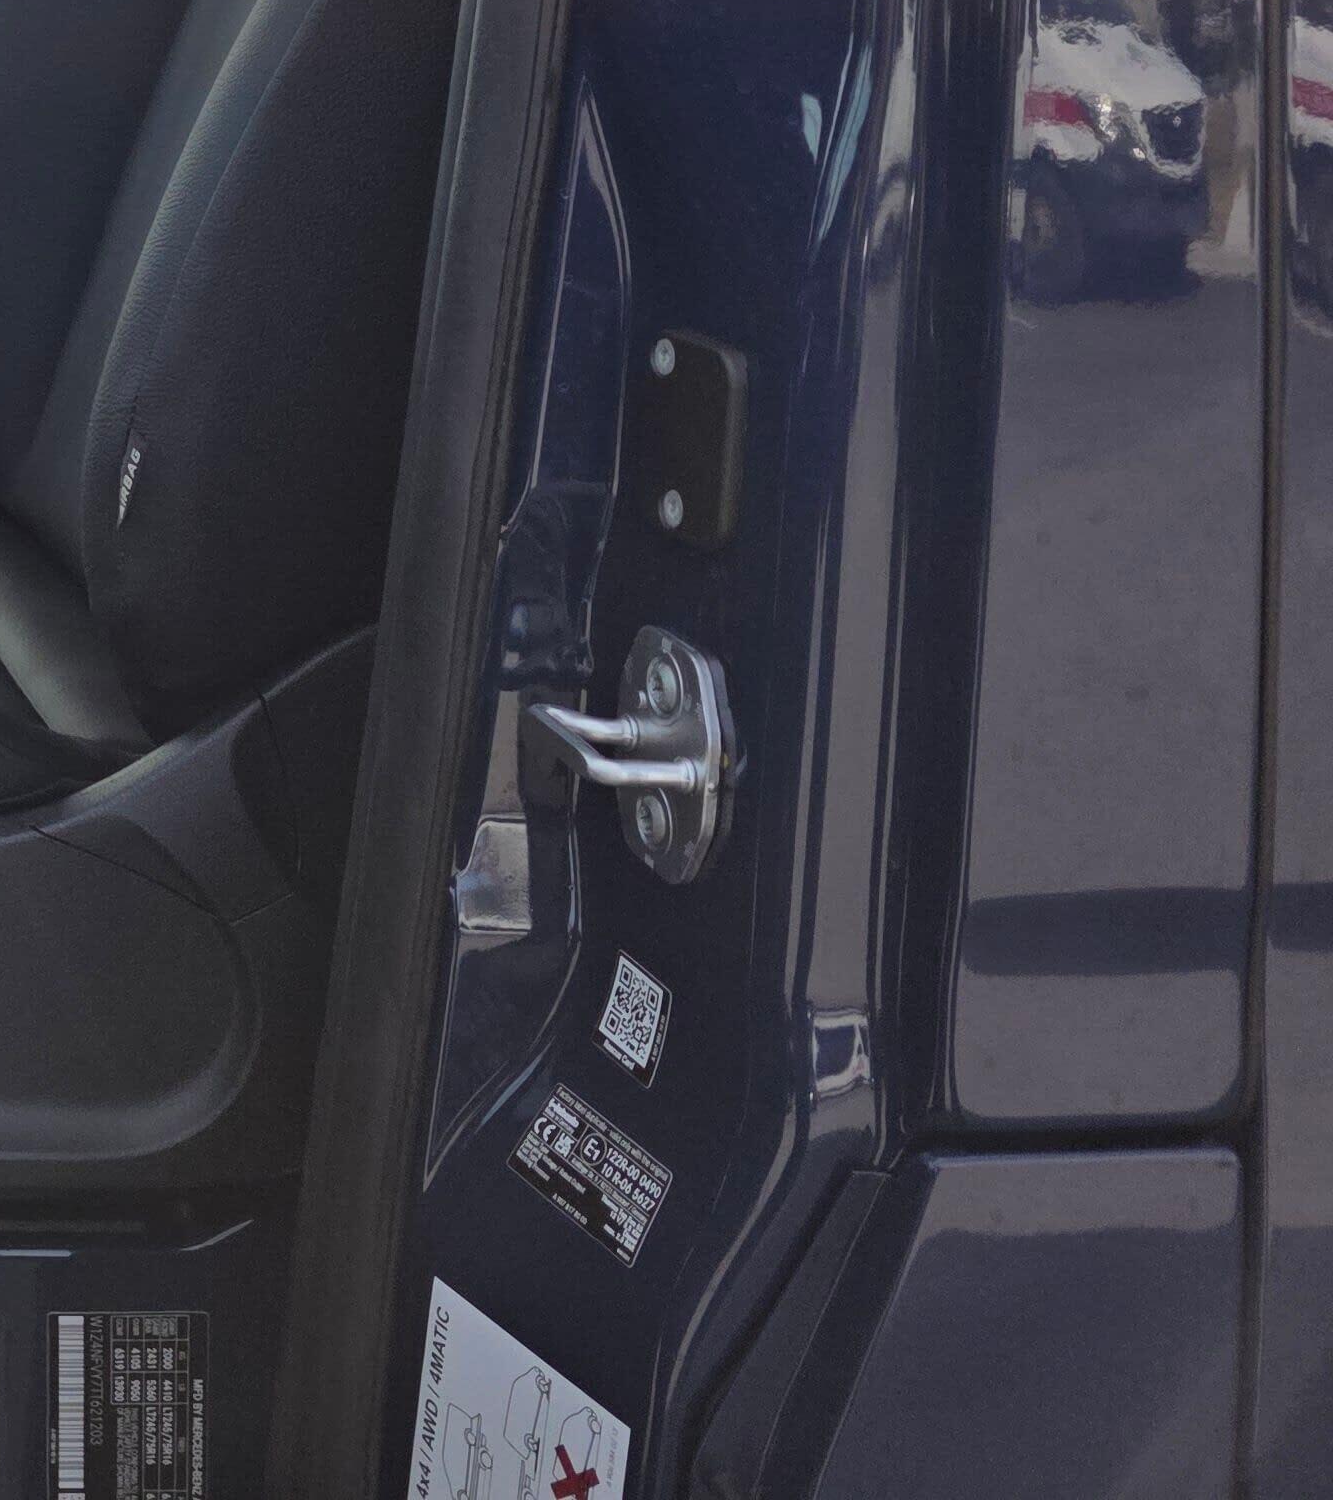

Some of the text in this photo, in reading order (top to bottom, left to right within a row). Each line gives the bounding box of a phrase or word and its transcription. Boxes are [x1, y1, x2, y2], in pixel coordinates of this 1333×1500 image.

[583, 1138, 601, 1161] E1
[606, 1148, 641, 1181] 122R-00
[639, 1174, 661, 1199] 0490
[601, 1162, 655, 1212] 10 R-06 5627
[429, 1306, 450, 1383] 4MATIC
[114, 1347, 125, 1369] 6319
[130, 1347, 140, 1369] 4105
[146, 1347, 156, 1369] 2431
[162, 1347, 172, 1369] 2000
[90, 1316, 102, 1445] W1Z4NFVY7TT621203
[114, 1375, 124, 1401] 13930
[130, 1379, 139, 1401] 9050
[146, 1379, 156, 1401] 5360
[162, 1379, 172, 1401] 4410
[192, 1379, 202, 1400] MFD
[192, 1402, 202, 1414] BY
[422, 1398, 438, 1447] AWD
[145, 1406, 156, 1464] LT245/75R16
[161, 1406, 172, 1465] LT245/75R16
[191, 1417, 202, 1495] MERCEDES-BENZ
[416, 1463, 431, 1500] 4x4
